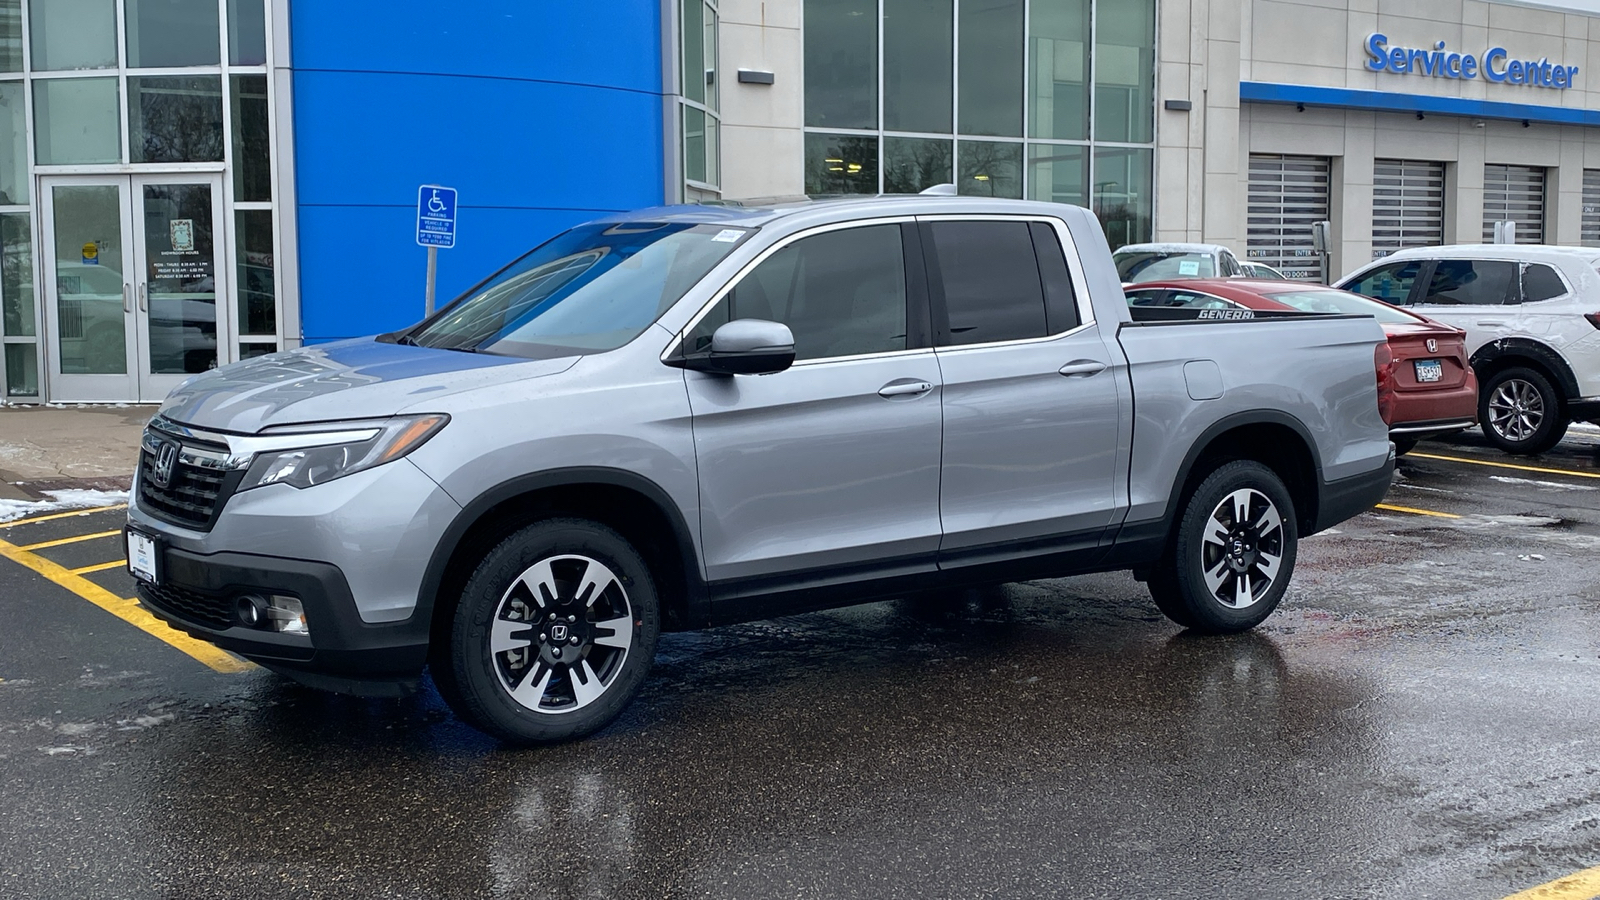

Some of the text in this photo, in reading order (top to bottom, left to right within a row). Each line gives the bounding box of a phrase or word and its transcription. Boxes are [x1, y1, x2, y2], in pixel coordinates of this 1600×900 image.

[1364, 33, 1579, 89] Service Center
[469, 546, 531, 638] YOKOHAMA
